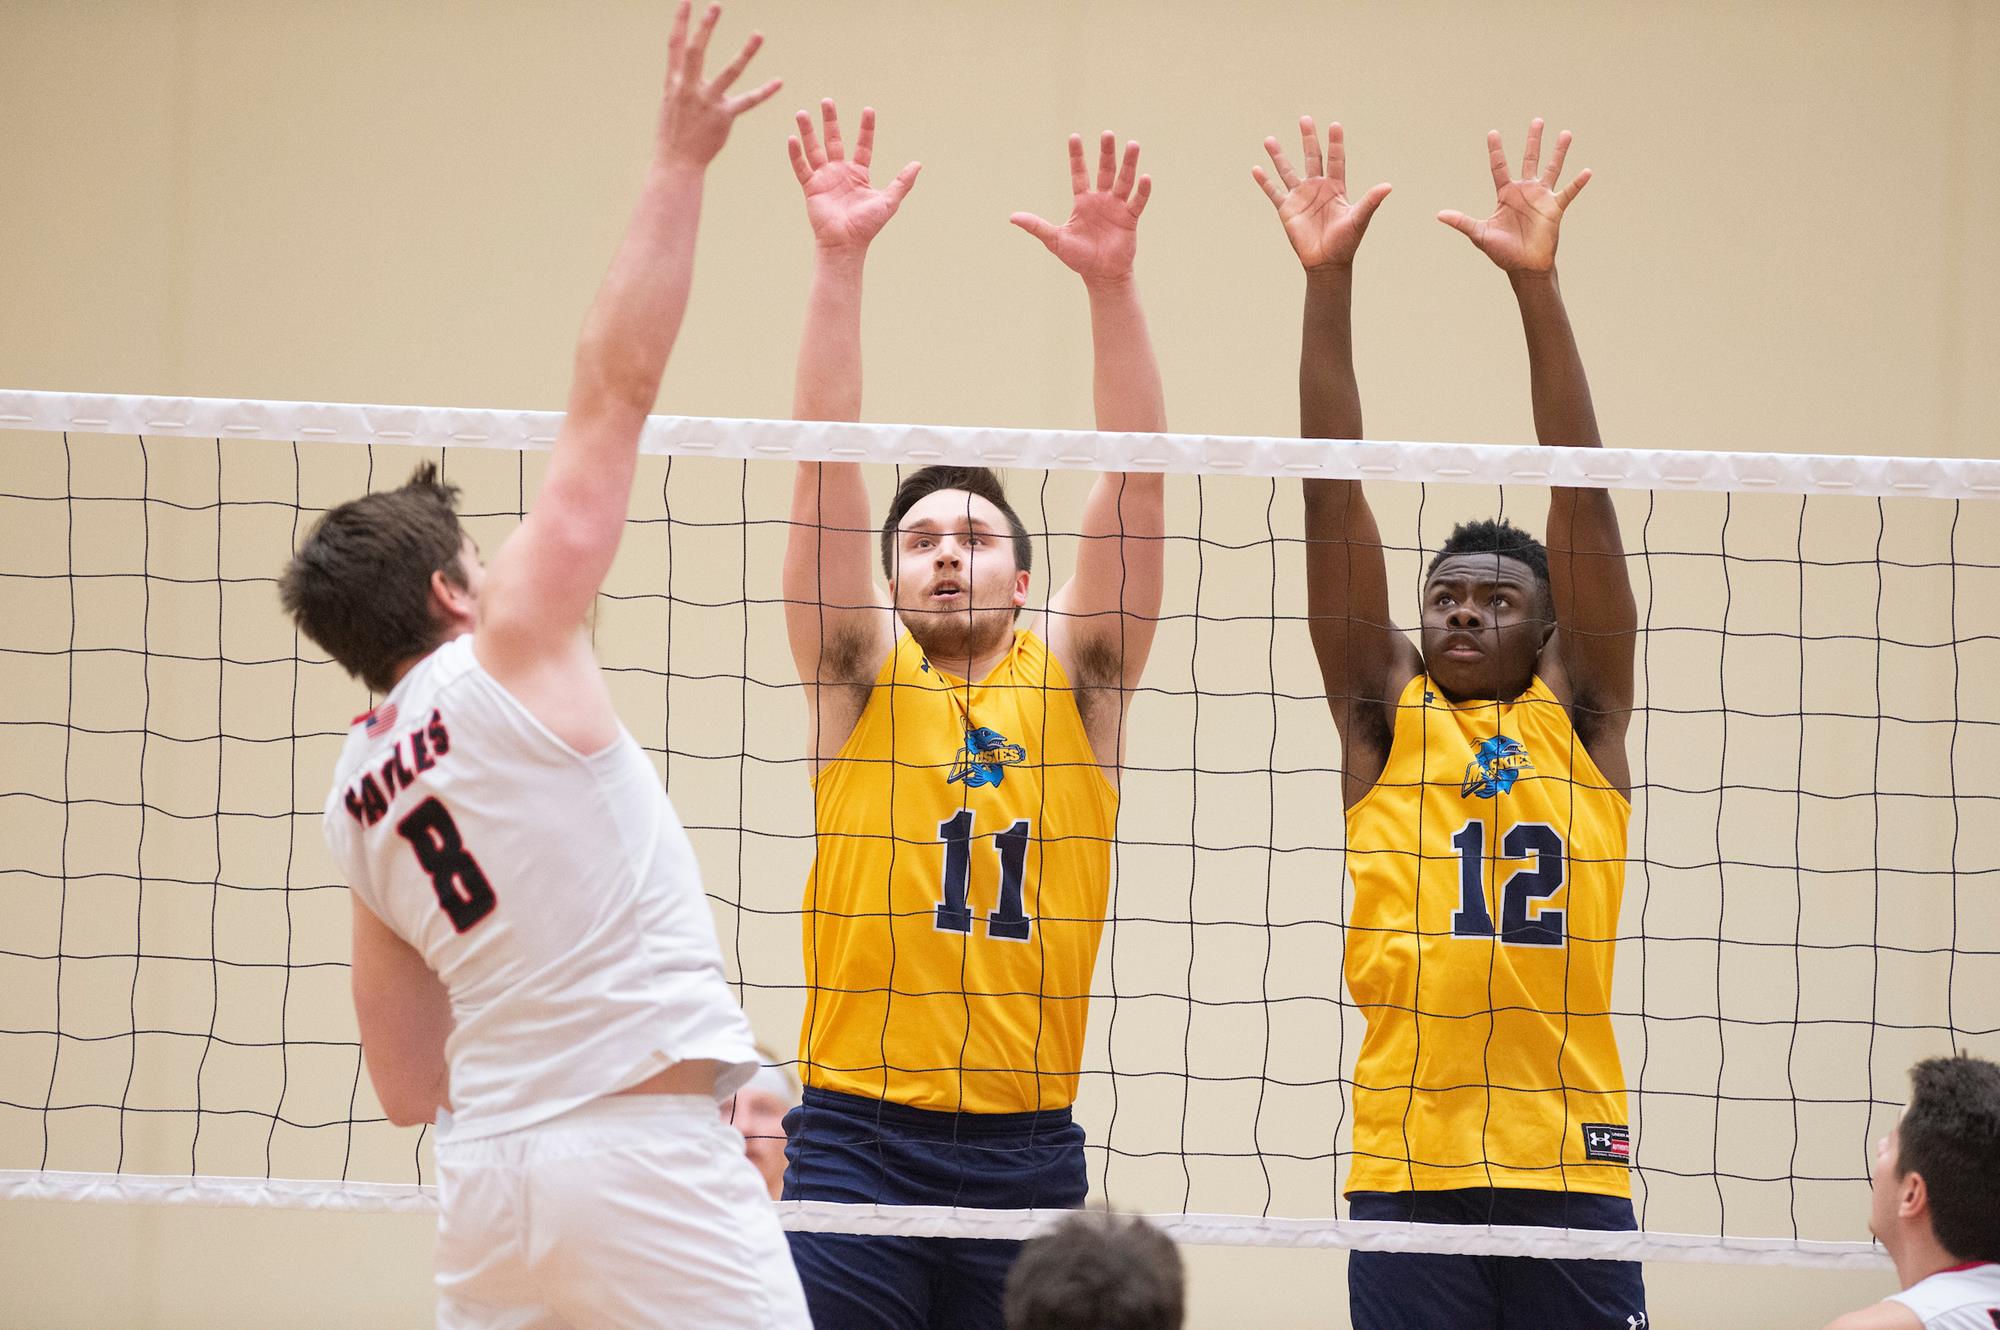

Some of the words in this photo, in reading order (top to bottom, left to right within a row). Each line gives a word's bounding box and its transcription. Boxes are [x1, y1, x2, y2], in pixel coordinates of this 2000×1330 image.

[396, 794, 497, 935] 8
[933, 807, 1033, 943] 11
[1450, 818, 1566, 948] 12
